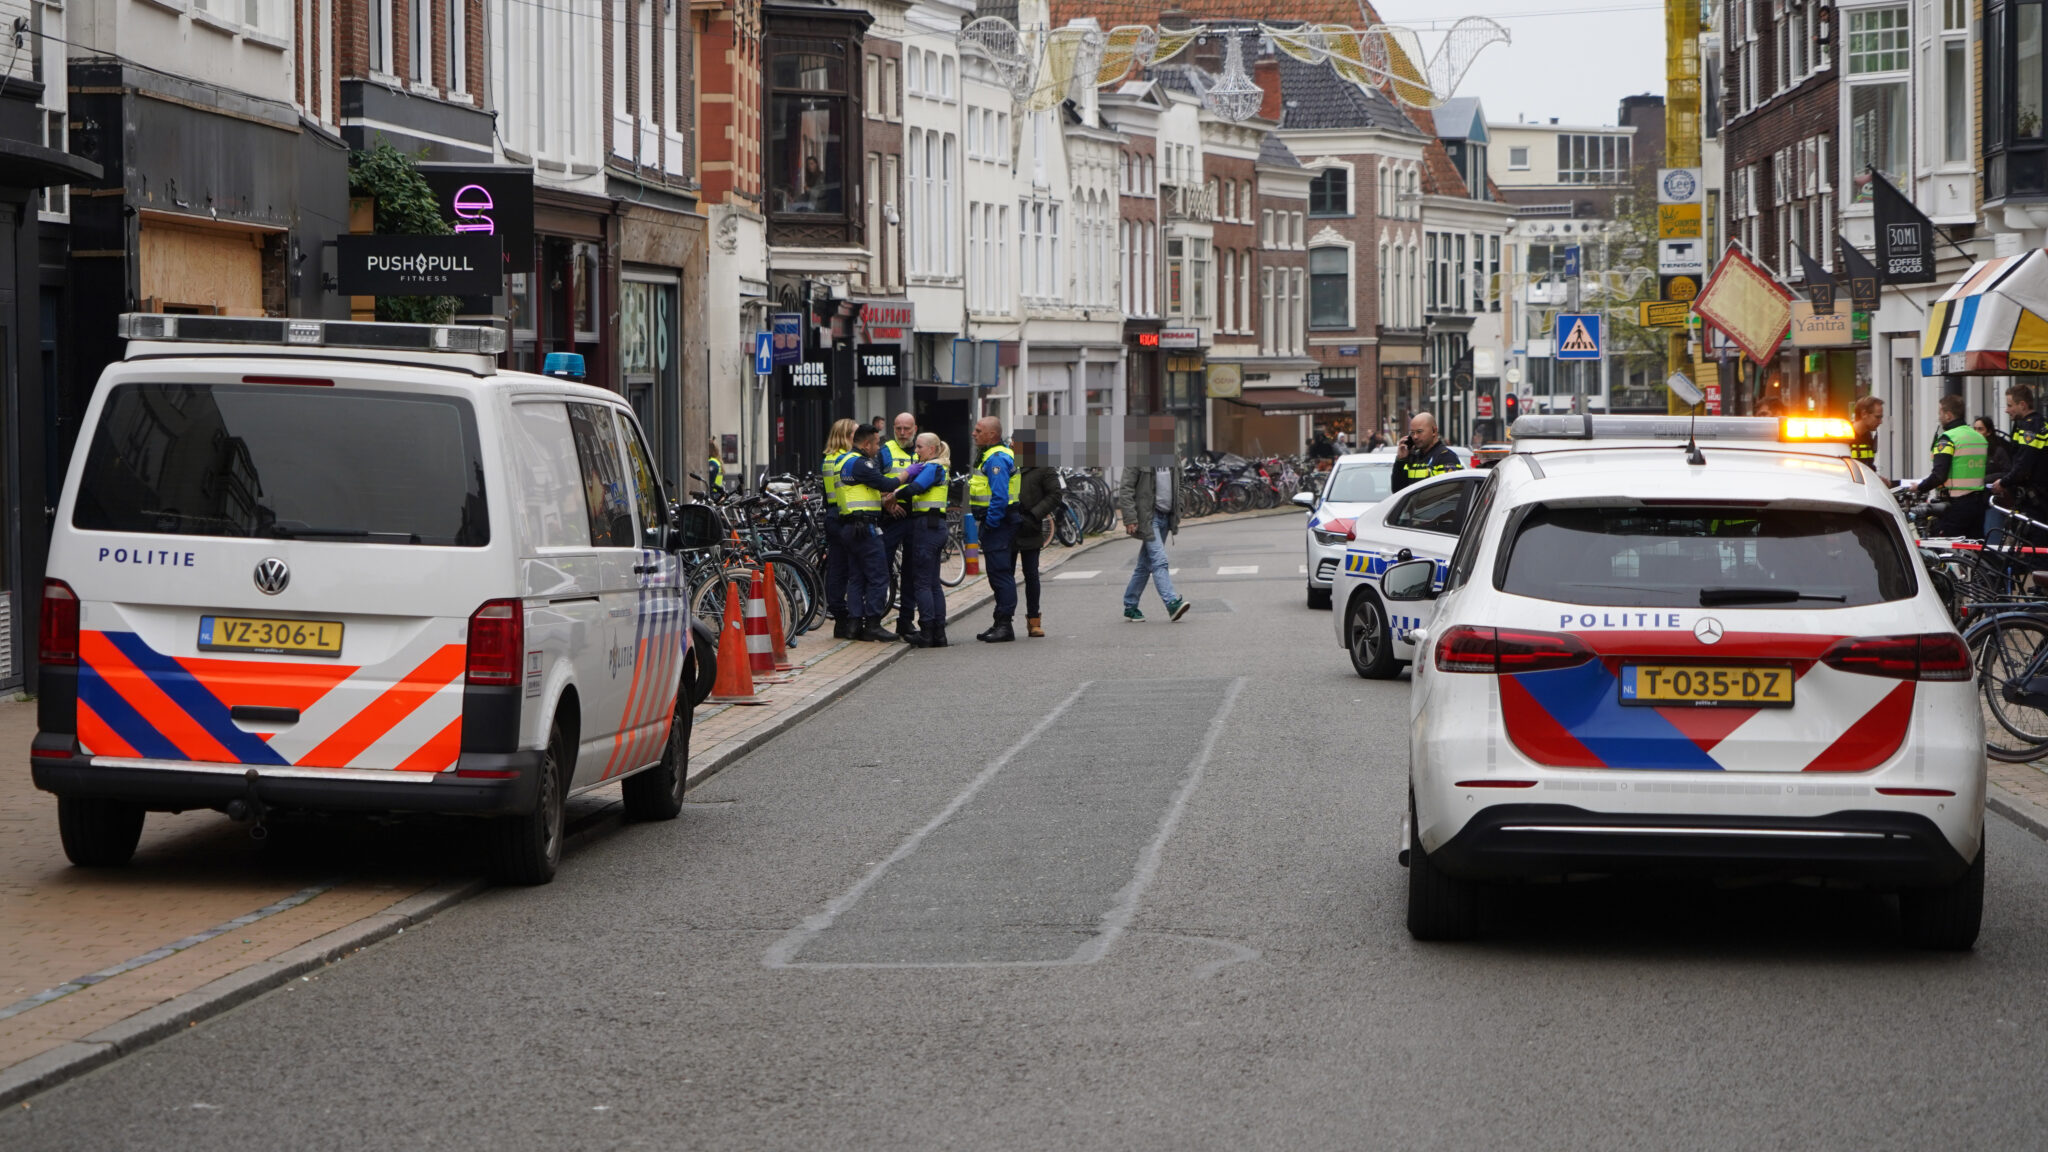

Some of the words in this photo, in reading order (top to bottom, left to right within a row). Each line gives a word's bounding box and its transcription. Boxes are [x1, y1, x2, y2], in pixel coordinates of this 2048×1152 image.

[1670, 178, 1690, 189] Lee
[1889, 227, 1918, 246] 30ML
[367, 256, 414, 271] PUSH
[428, 256, 474, 271] PULL
[1889, 258, 1922, 266] COFFEE
[1889, 265, 1922, 274] &FOOD
[1796, 319, 1845, 332] Yantra
[863, 355, 893, 366] TRAIN
[867, 365, 896, 376] MORE
[793, 374, 828, 386] MORE
[99, 547, 195, 567] POLITIE
[1559, 613, 1681, 629] POLITIE
[201, 633, 212, 641] NL
[223, 621, 330, 647] VZ-306-L
[1623, 685, 1635, 694] NL
[1644, 670, 1780, 698] T-035-DZ
